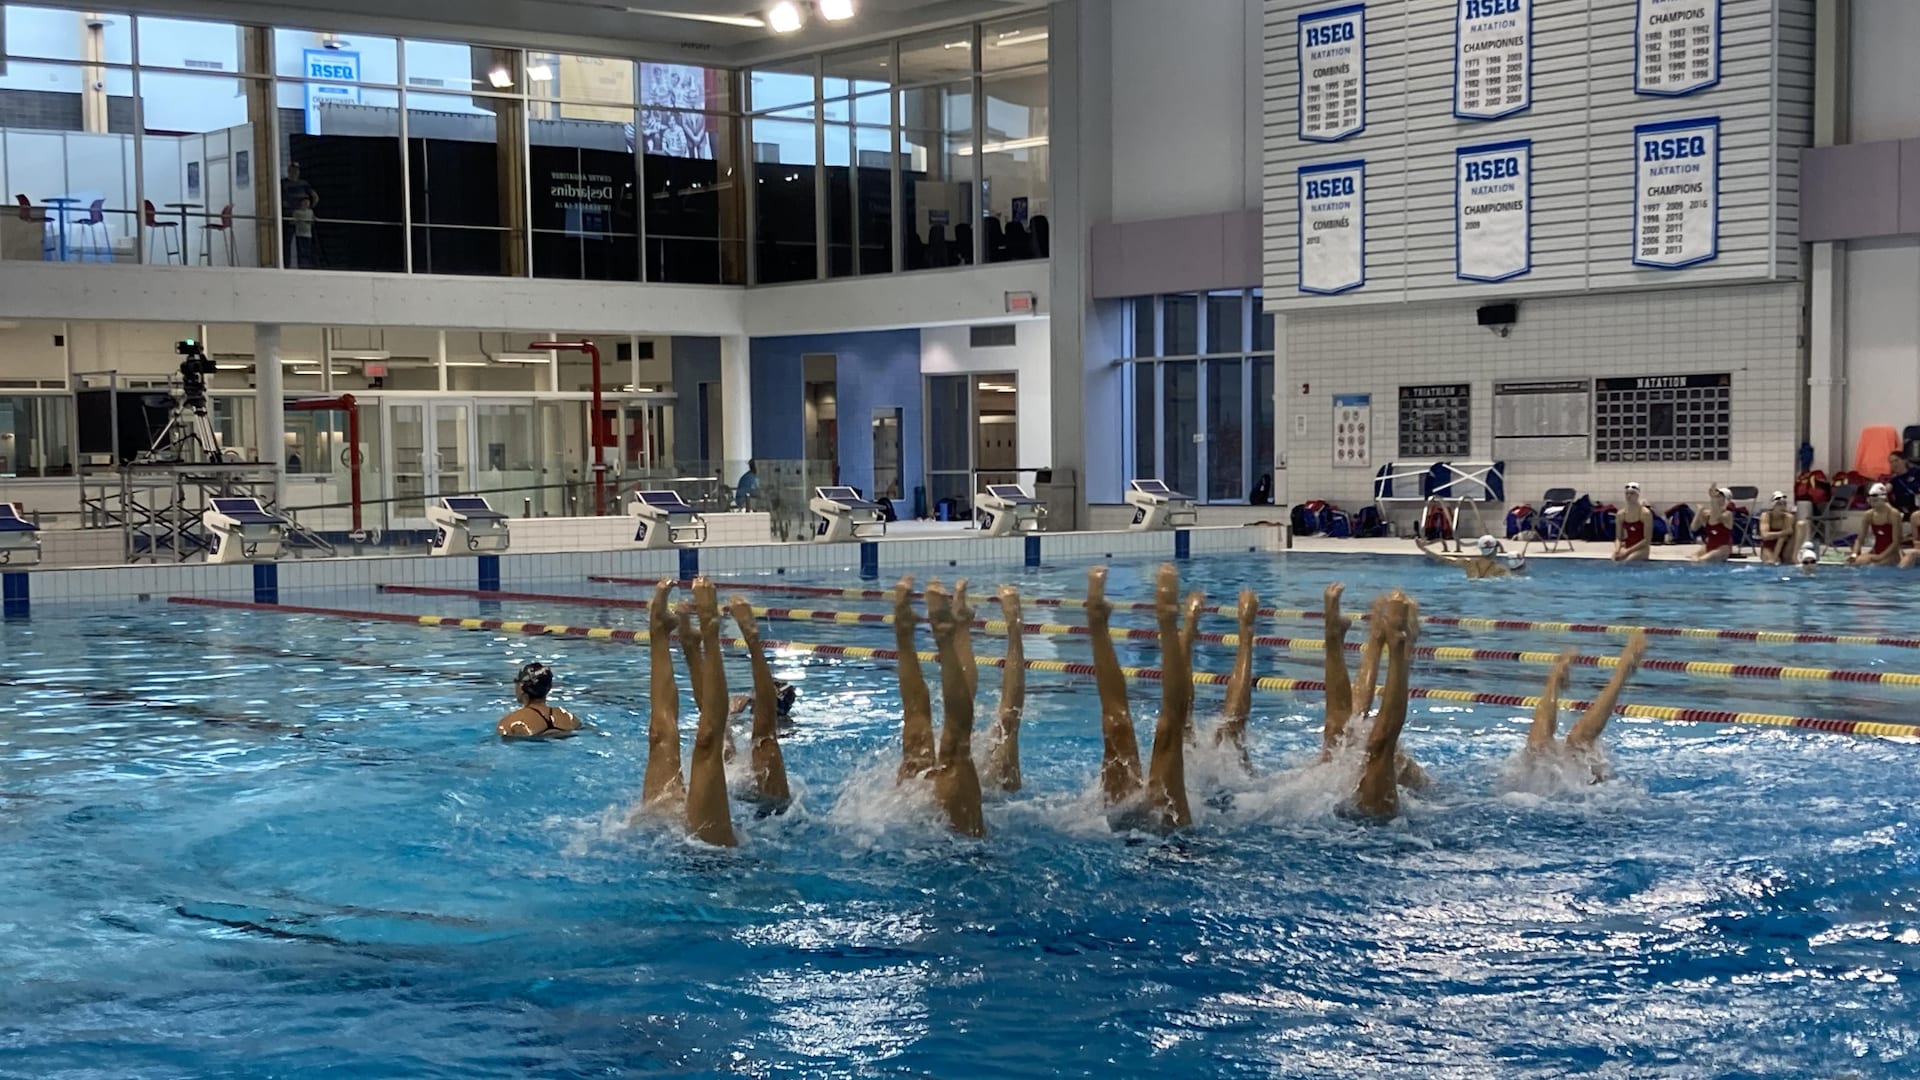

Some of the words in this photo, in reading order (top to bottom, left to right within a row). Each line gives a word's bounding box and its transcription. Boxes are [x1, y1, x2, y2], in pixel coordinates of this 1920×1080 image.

[1466, 0, 1520, 19] RSEQ
[1649, 8, 1705, 25] CHAMPIONS
[1471, 20, 1515, 33] NATATION
[1306, 22, 1354, 47] RSEQ
[1464, 36, 1523, 53] CHAMPIONNES
[1311, 47, 1350, 60] NATATION
[311, 63, 354, 79] RSEQ
[1313, 63, 1350, 78] COMBINÉS
[1668, 72, 1685, 82] 1991
[1644, 136, 1706, 162] RSEQ
[1465, 157, 1519, 182] RSEQ
[1650, 164, 1700, 176] NATATION
[1306, 176, 1355, 199] RSEQ
[1471, 183, 1515, 195] NATATION
[1648, 182, 1703, 197] CHAMPIONS
[1311, 201, 1350, 212] NATATION
[1464, 200, 1523, 215] CHAMPIONNES
[1313, 216, 1350, 230] COMBINÉS
[1666, 212, 1683, 222] 2010
[1666, 223, 1683, 232] 2011
[1666, 234, 1683, 244] 2012
[1665, 245, 1682, 254] 2013
[1637, 376, 1687, 389] NATATION
[1413, 386, 1456, 397] TRIATHLON
[246, 541, 259, 555] 4
[471, 535, 480, 549] 5
[0, 549, 11, 565] 3
